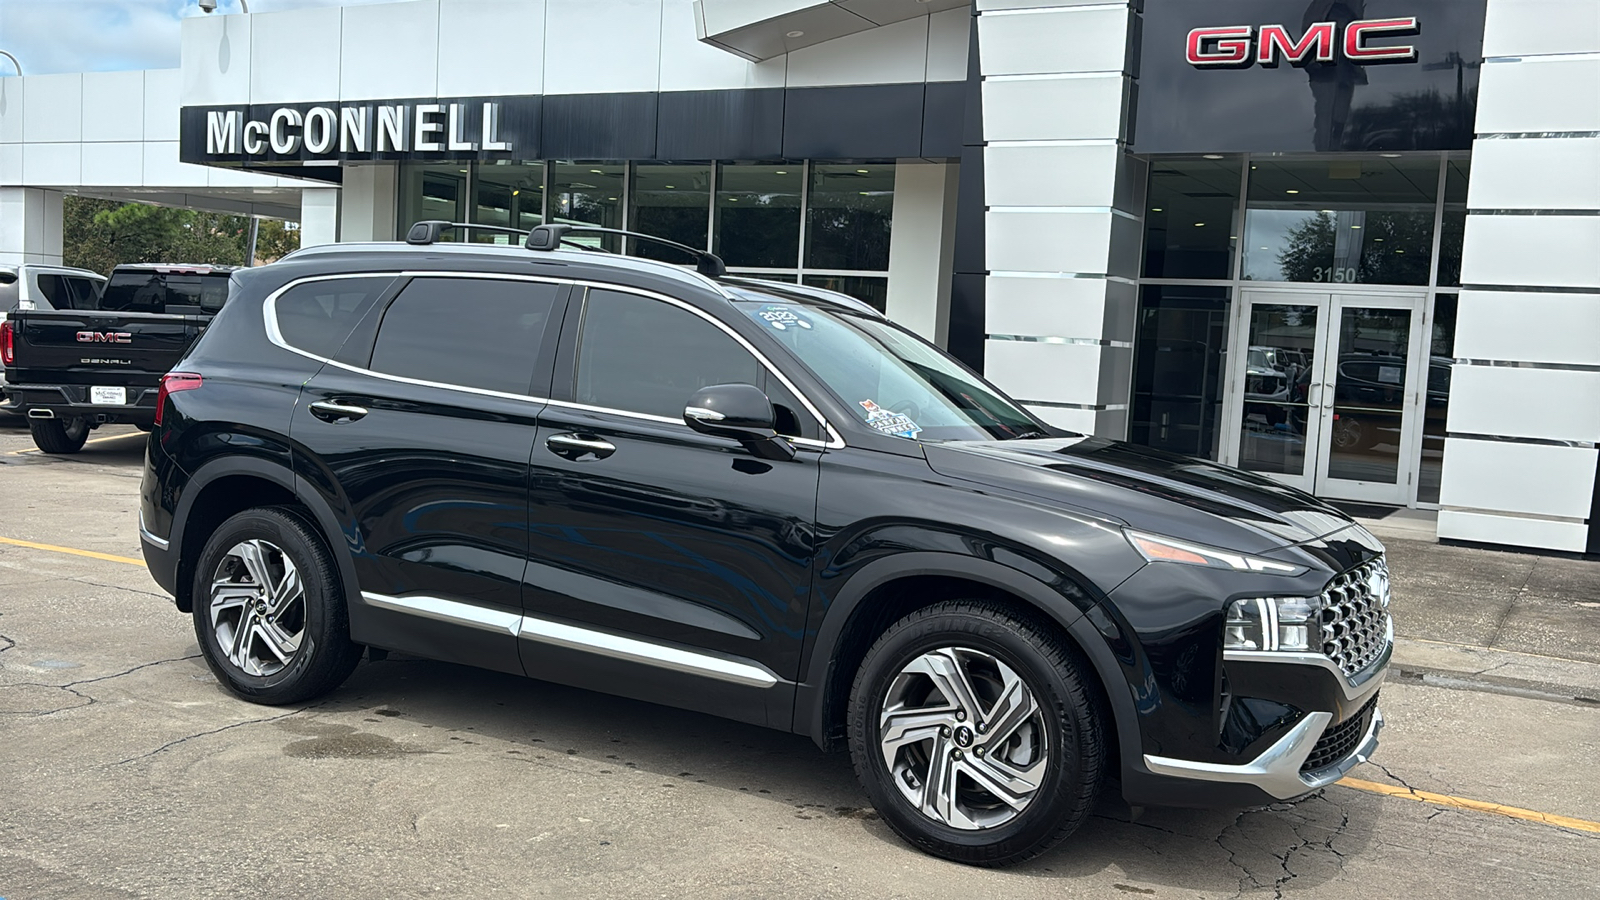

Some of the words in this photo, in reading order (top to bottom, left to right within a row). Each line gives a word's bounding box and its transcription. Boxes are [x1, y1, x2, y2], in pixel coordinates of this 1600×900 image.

[1186, 17, 1416, 65] GMC
[206, 102, 509, 154] McCONNELL
[1312, 266, 1356, 283] 3150
[76, 331, 132, 343] GMC
